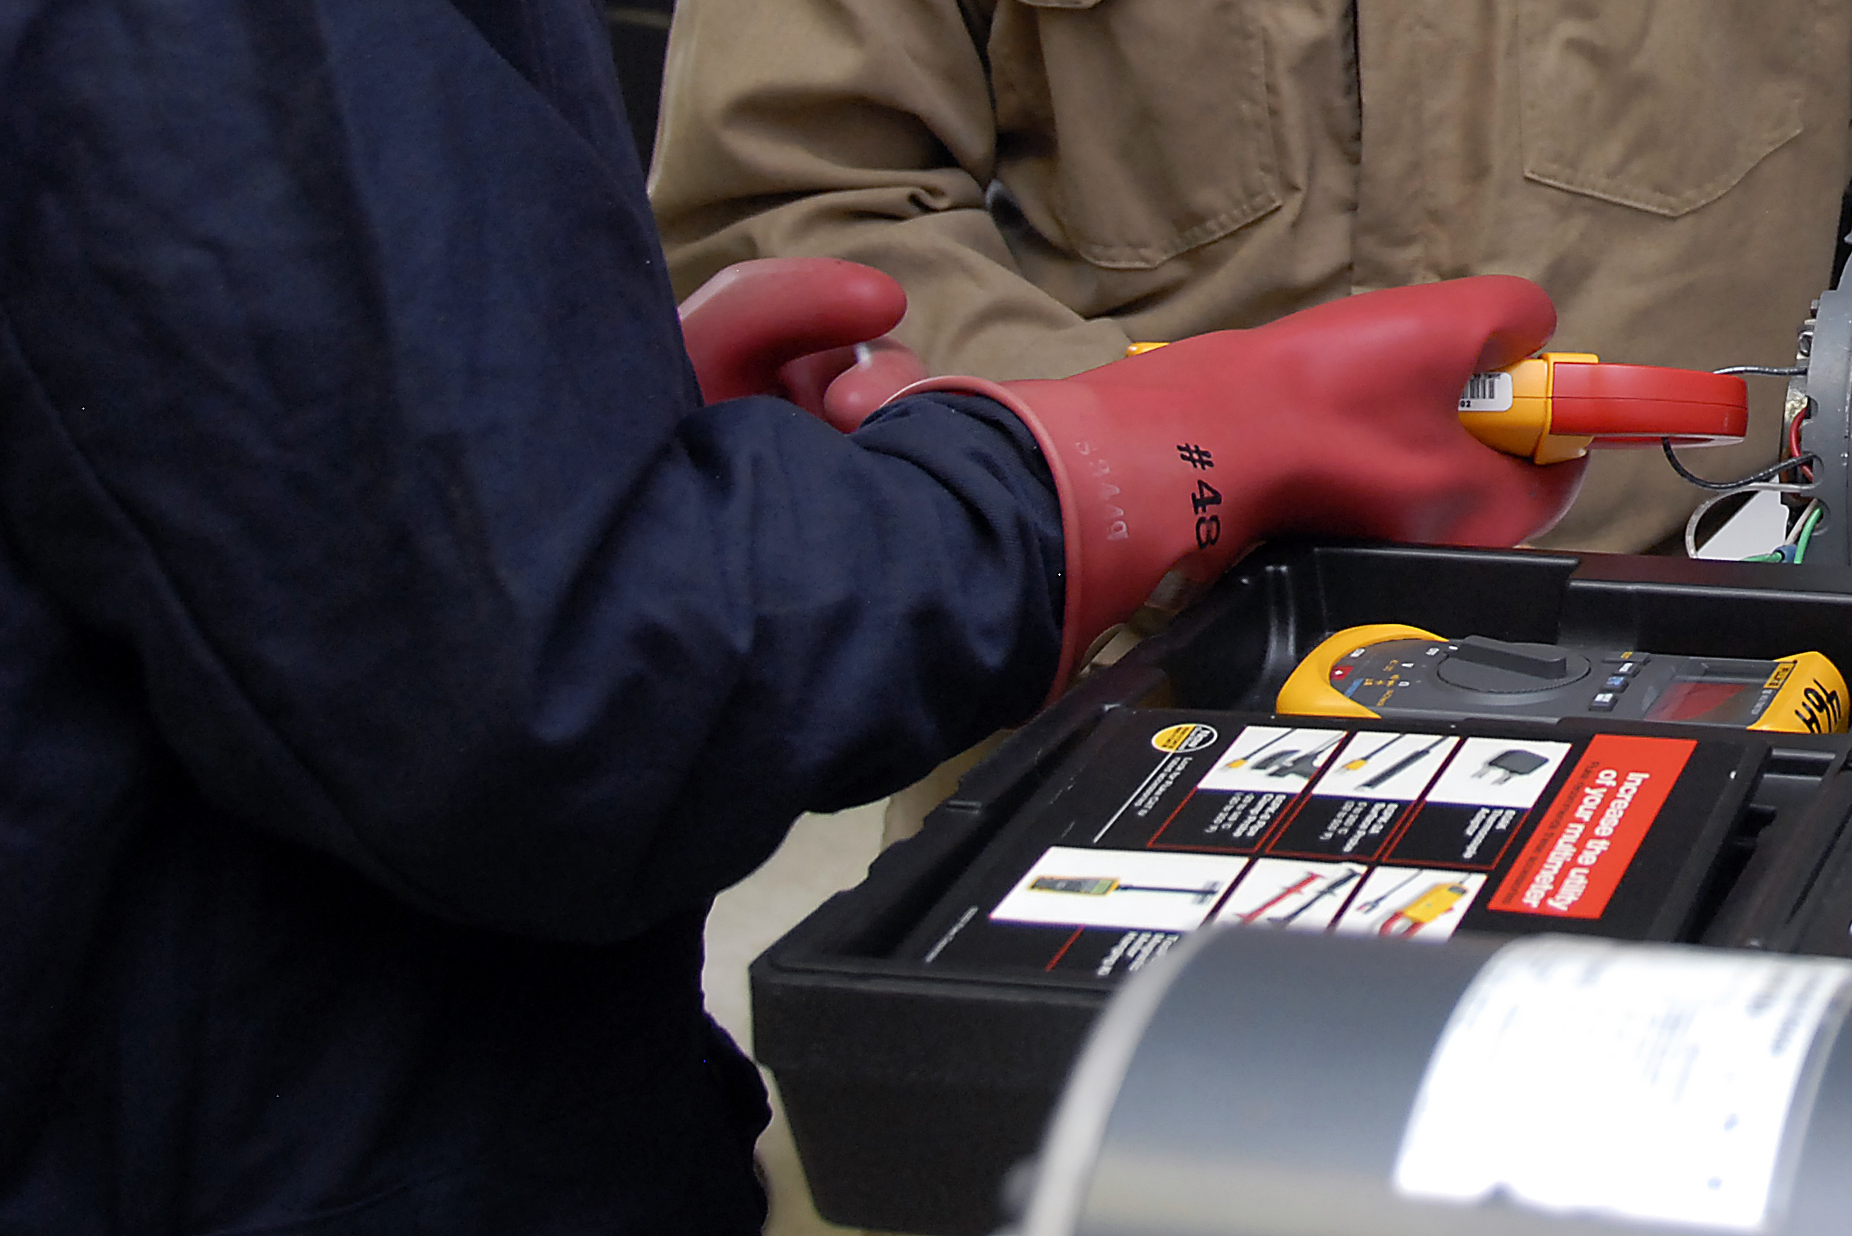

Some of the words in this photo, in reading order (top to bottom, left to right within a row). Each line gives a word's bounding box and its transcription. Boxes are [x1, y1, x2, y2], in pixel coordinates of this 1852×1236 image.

[1595, 769, 1618, 787] of
[1574, 786, 1608, 823] your
[1594, 771, 1650, 837] Increase
[1521, 822, 1586, 909] multimeter
[1576, 839, 1611, 866] the
[1546, 866, 1590, 912] utility
